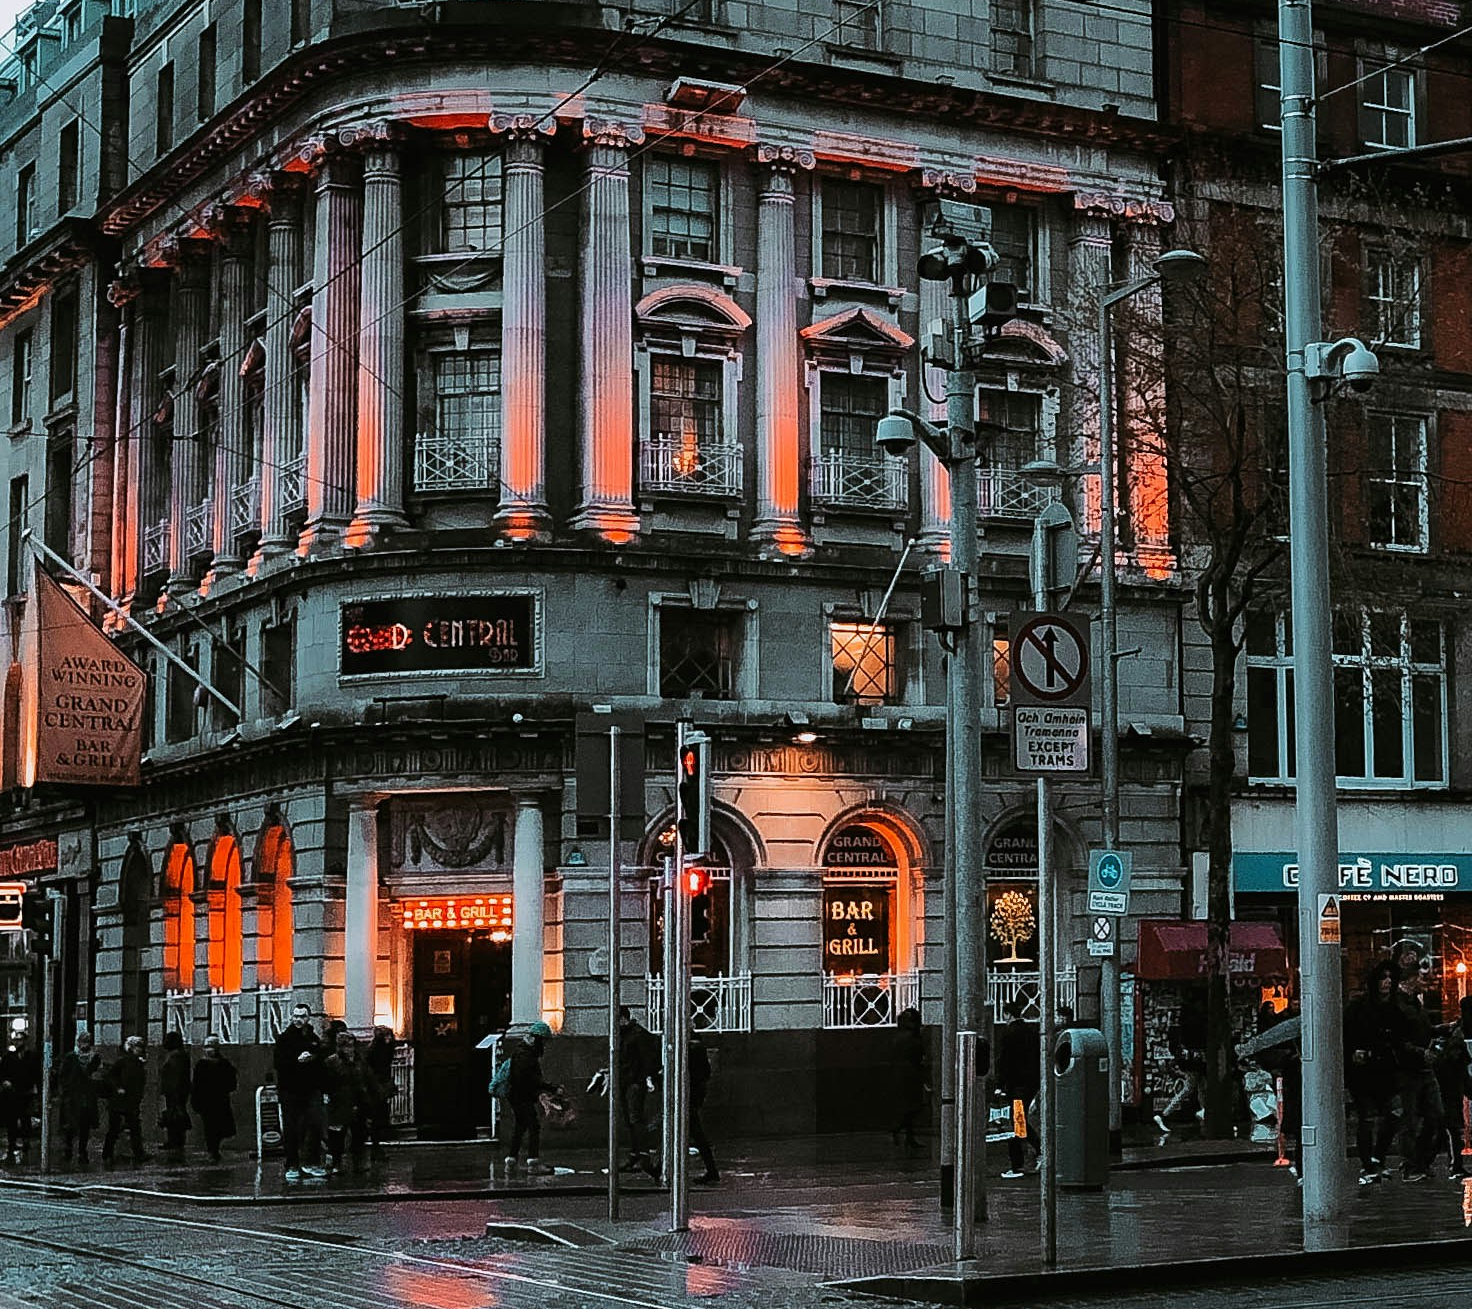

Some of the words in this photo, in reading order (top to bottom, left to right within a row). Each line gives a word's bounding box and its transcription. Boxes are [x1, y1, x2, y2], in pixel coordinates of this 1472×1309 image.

[60, 656, 126, 673] AWARD
[51, 668, 136, 688] WINNING
[55, 694, 128, 713] GRAND
[44, 713, 138, 732] CENTRAL
[76, 739, 111, 753] BAR
[1028, 741, 1075, 753] EXCEPT
[1030, 754, 1074, 767] TRAMS
[833, 836, 881, 848] GRAND
[826, 852, 888, 864] CENTRAL
[988, 853, 1038, 864] CENTRA
[1283, 857, 1372, 887] CFÈ
[1380, 864, 1458, 887] NERO
[414, 907, 443, 921] BAR
[446, 906, 458, 919] &
[460, 906, 499, 919] GRILL
[832, 901, 875, 920] BAR
[846, 922, 858, 936] &
[829, 937, 879, 955] GRILL
